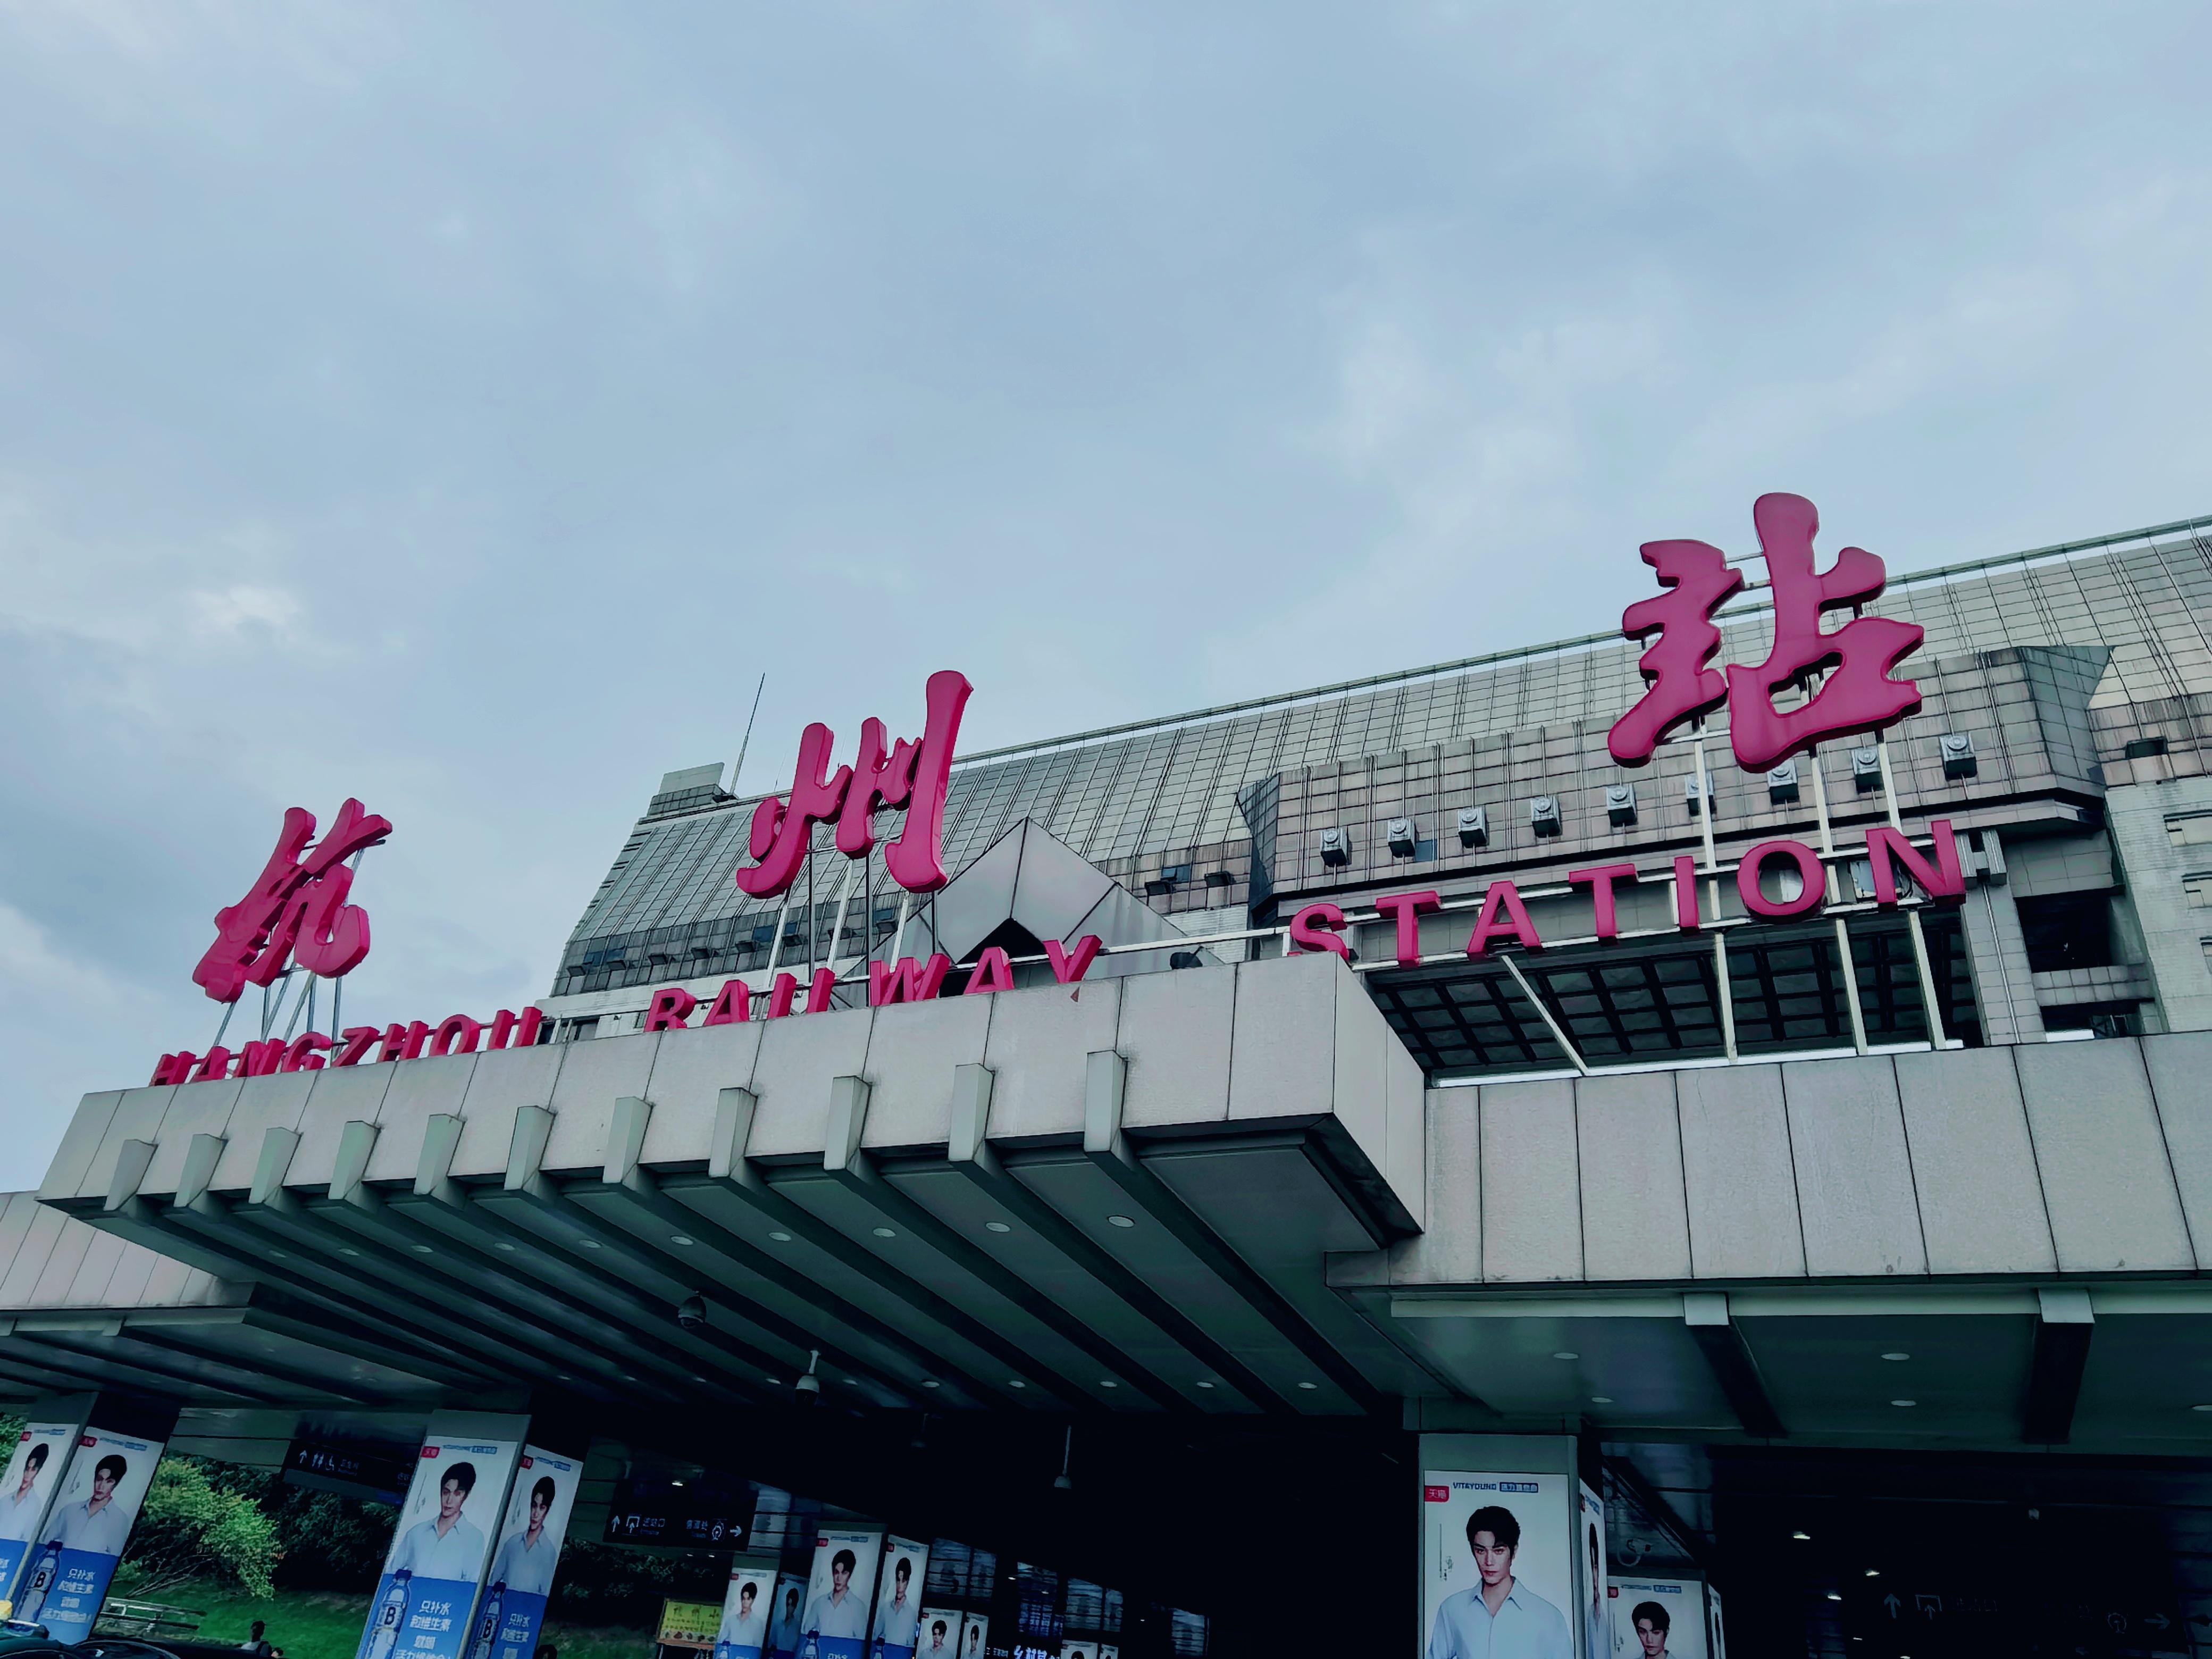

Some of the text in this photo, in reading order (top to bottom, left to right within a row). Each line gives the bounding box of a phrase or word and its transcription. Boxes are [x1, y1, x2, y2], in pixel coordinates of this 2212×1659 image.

[149, 819, 1966, 1086] HANGZHOU RAILWAY STATION
